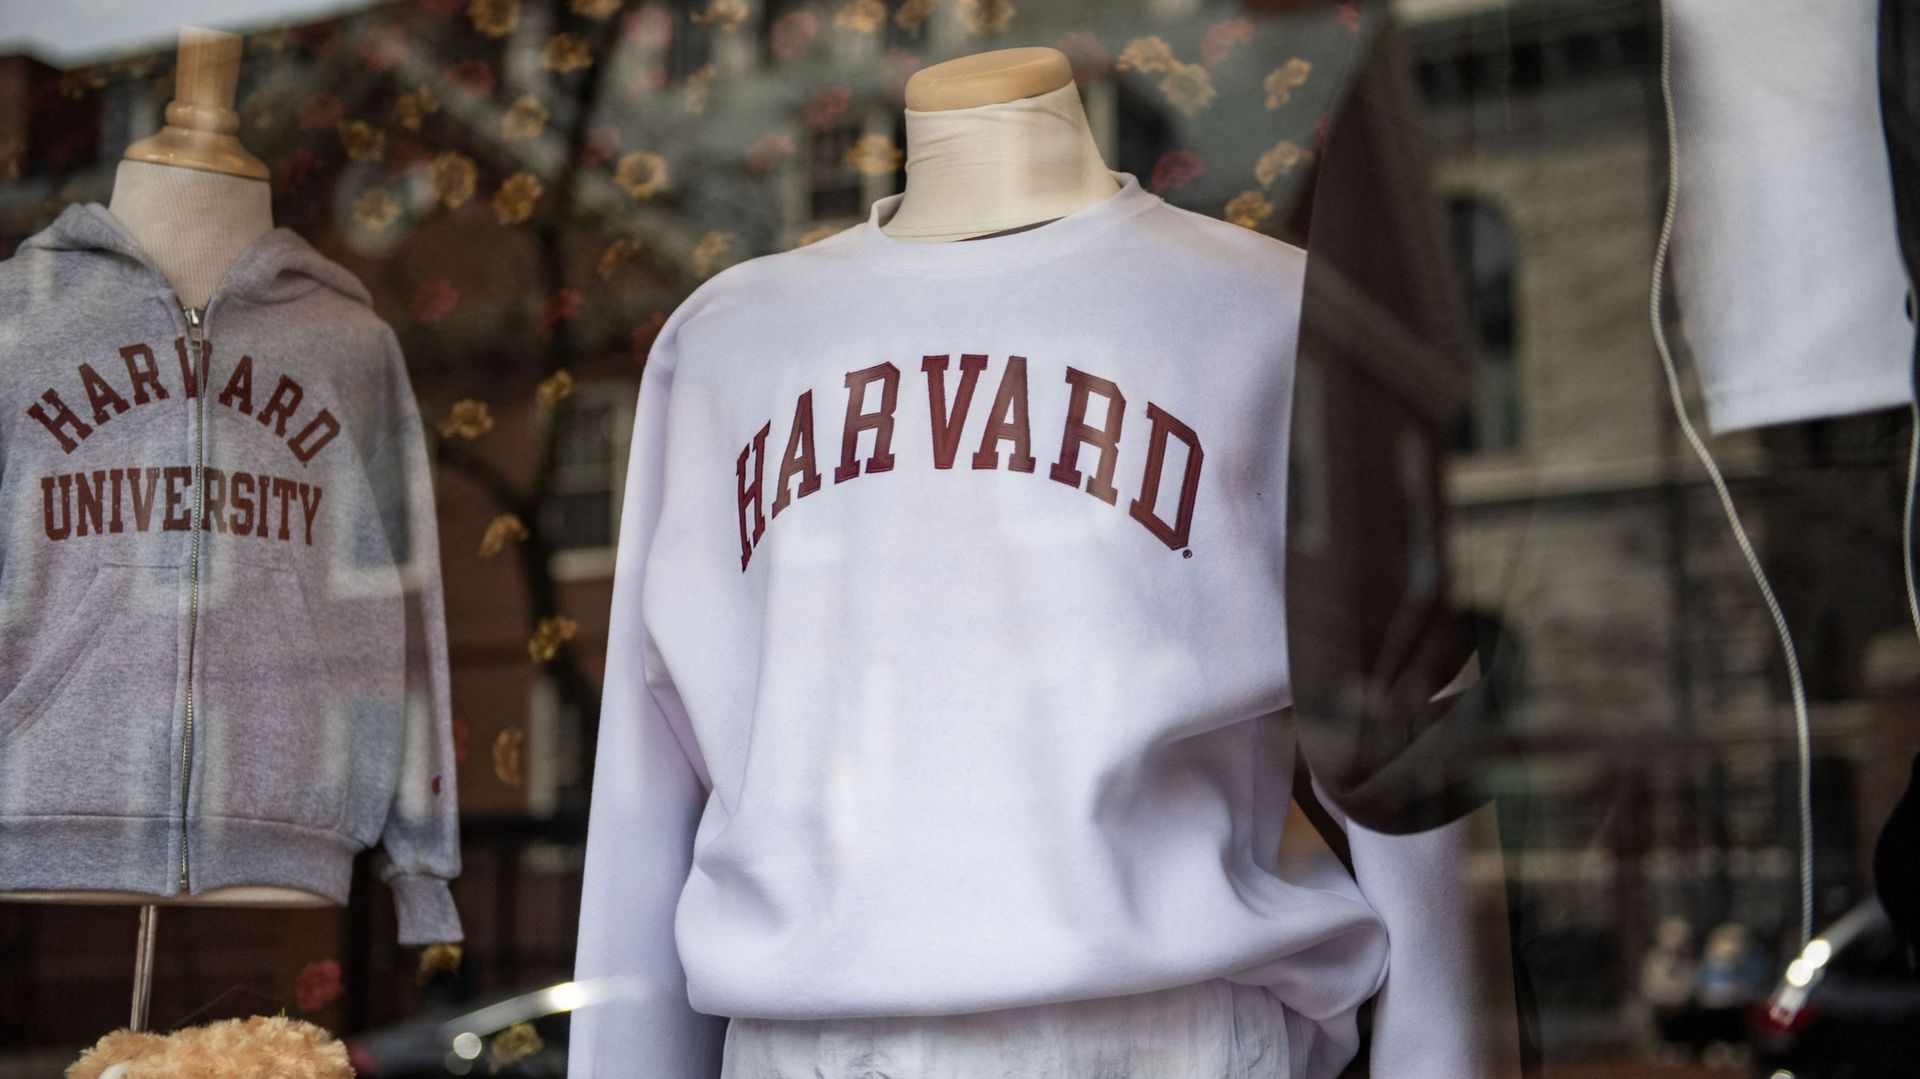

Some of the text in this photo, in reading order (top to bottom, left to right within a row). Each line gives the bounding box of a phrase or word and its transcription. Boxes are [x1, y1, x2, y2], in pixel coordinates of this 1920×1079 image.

[27, 336, 341, 462] HARVARD
[40, 466, 323, 546] UNIVERSITY
[736, 354, 1205, 573] HARVARD
